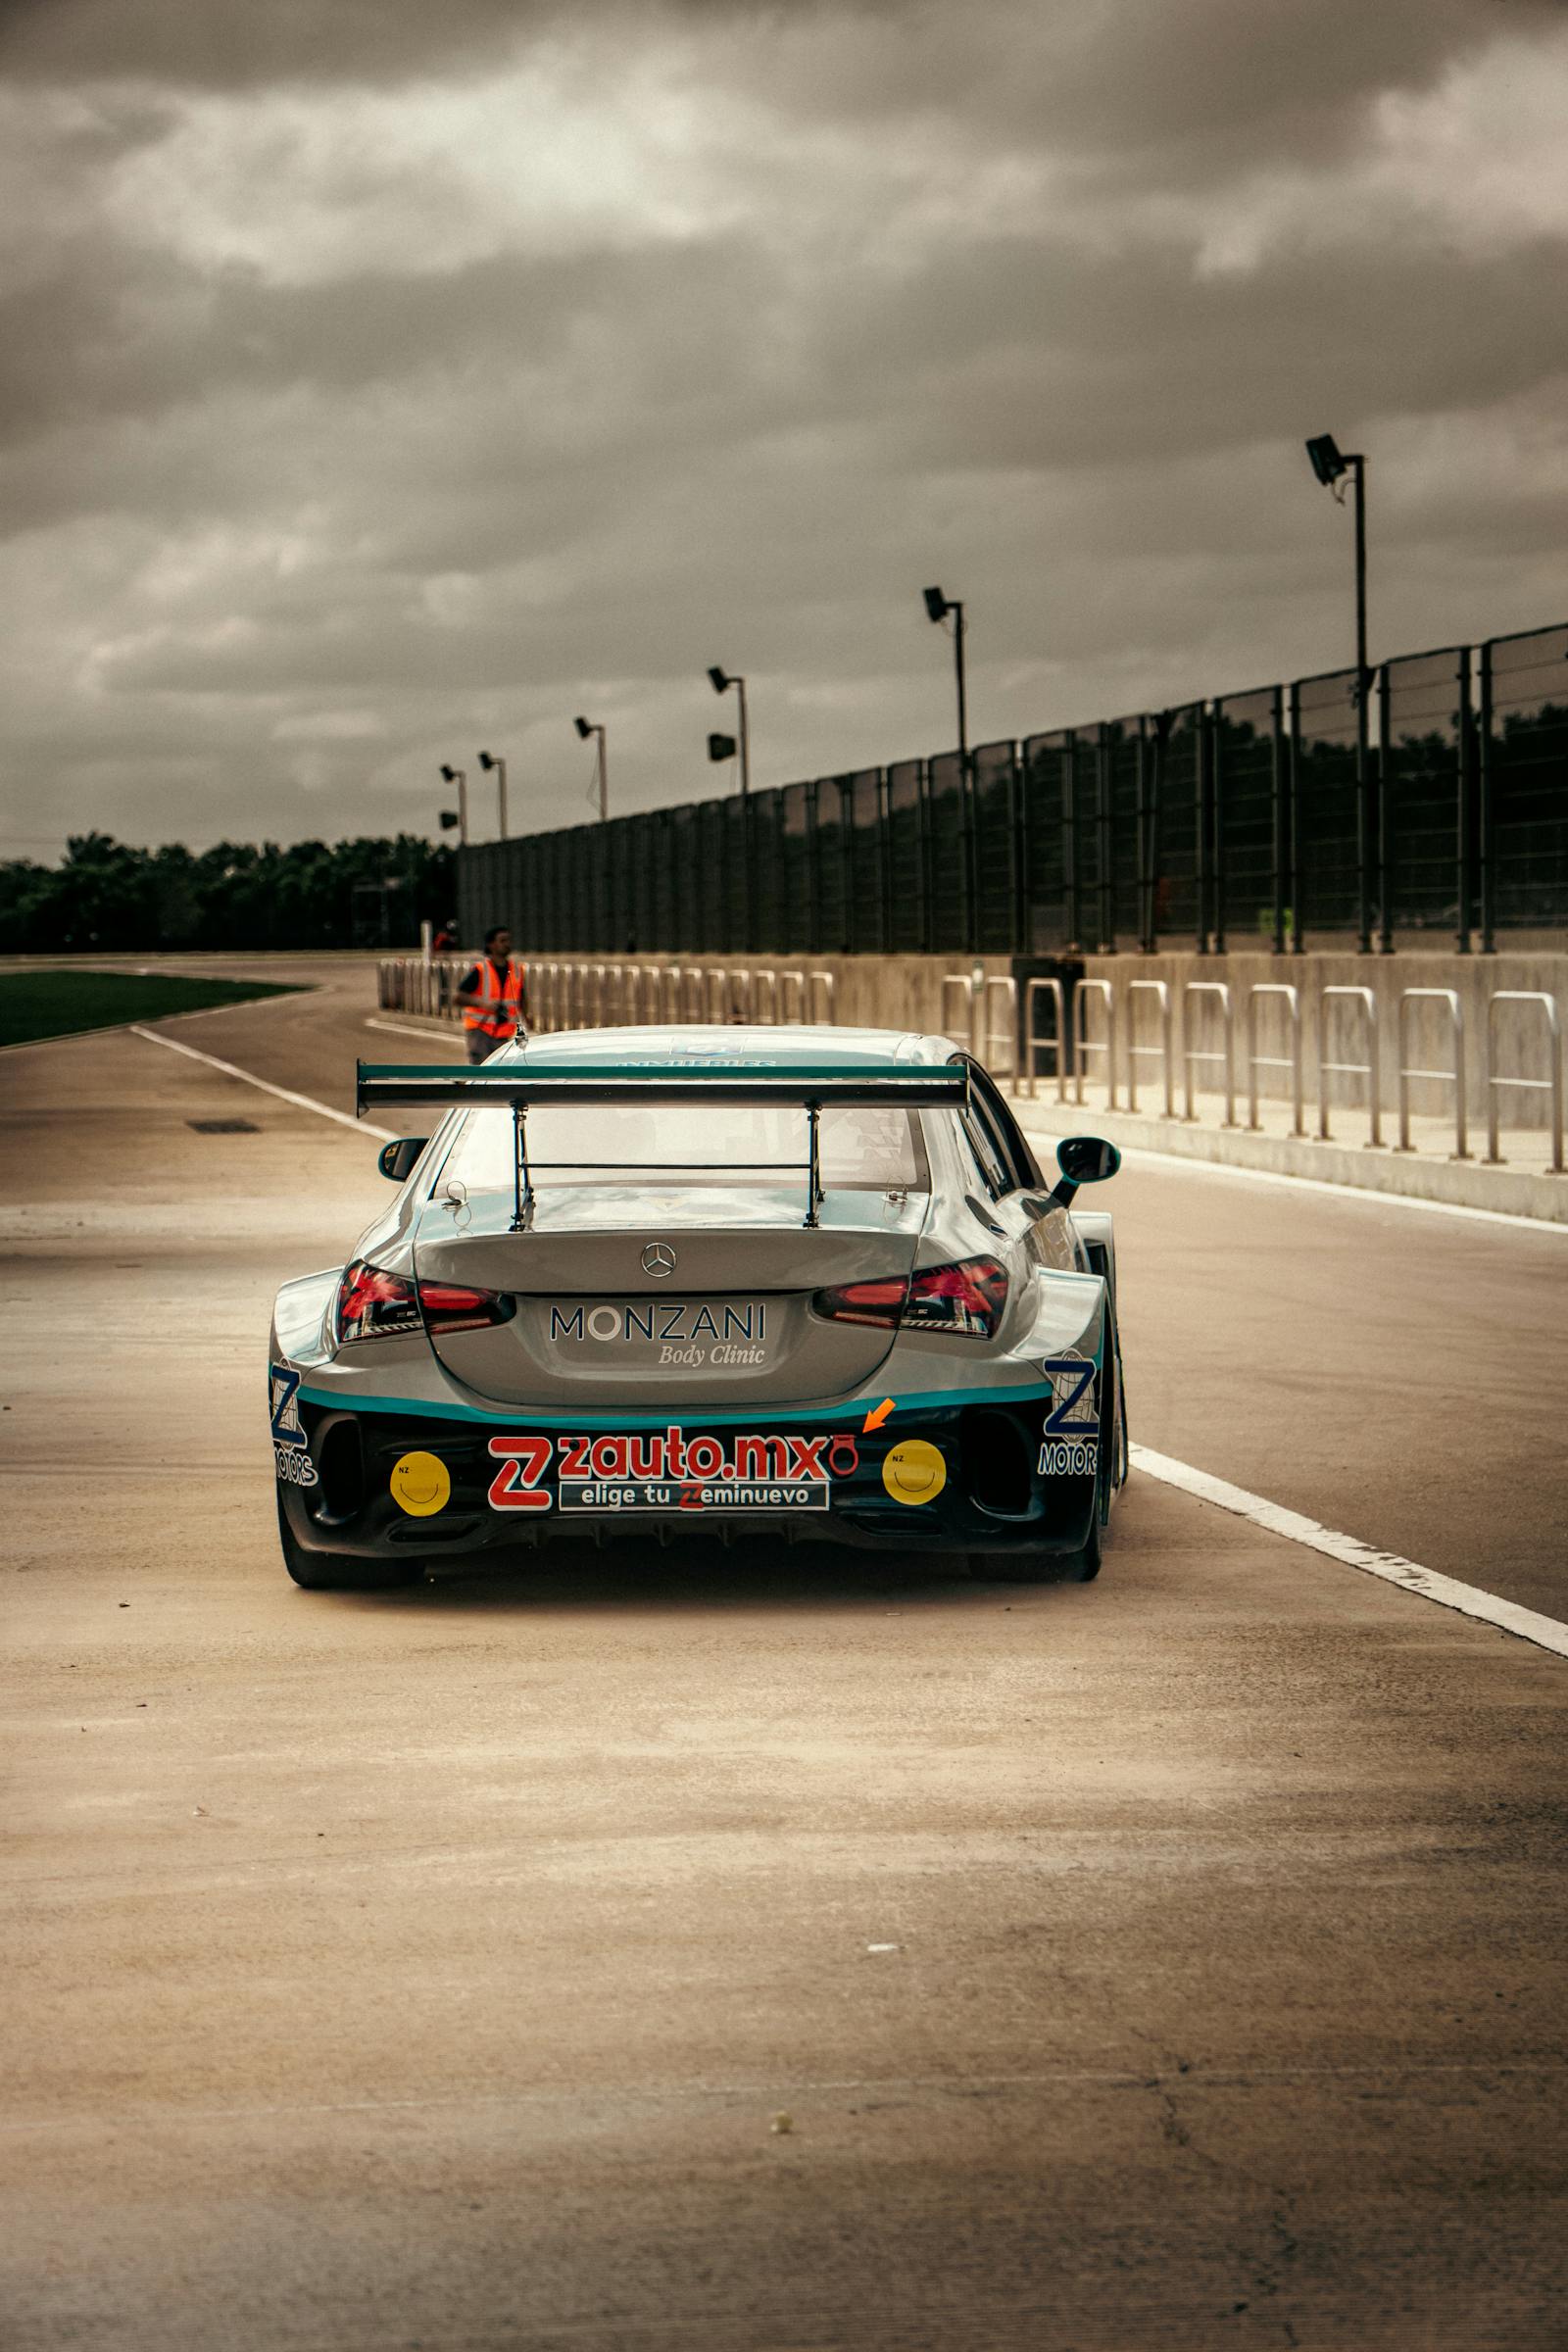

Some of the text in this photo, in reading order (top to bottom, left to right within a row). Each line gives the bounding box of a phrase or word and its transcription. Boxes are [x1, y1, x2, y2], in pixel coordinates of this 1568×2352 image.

[550, 1303, 766, 1342] MONZANI
[659, 1345, 765, 1368] Body Clinic
[1044, 1357, 1099, 1437] Z
[558, 1426, 832, 1482] zauto.mx
[1037, 1443, 1099, 1476] MOTOR
[581, 1480, 809, 1512] elige tu Zeminuevo
